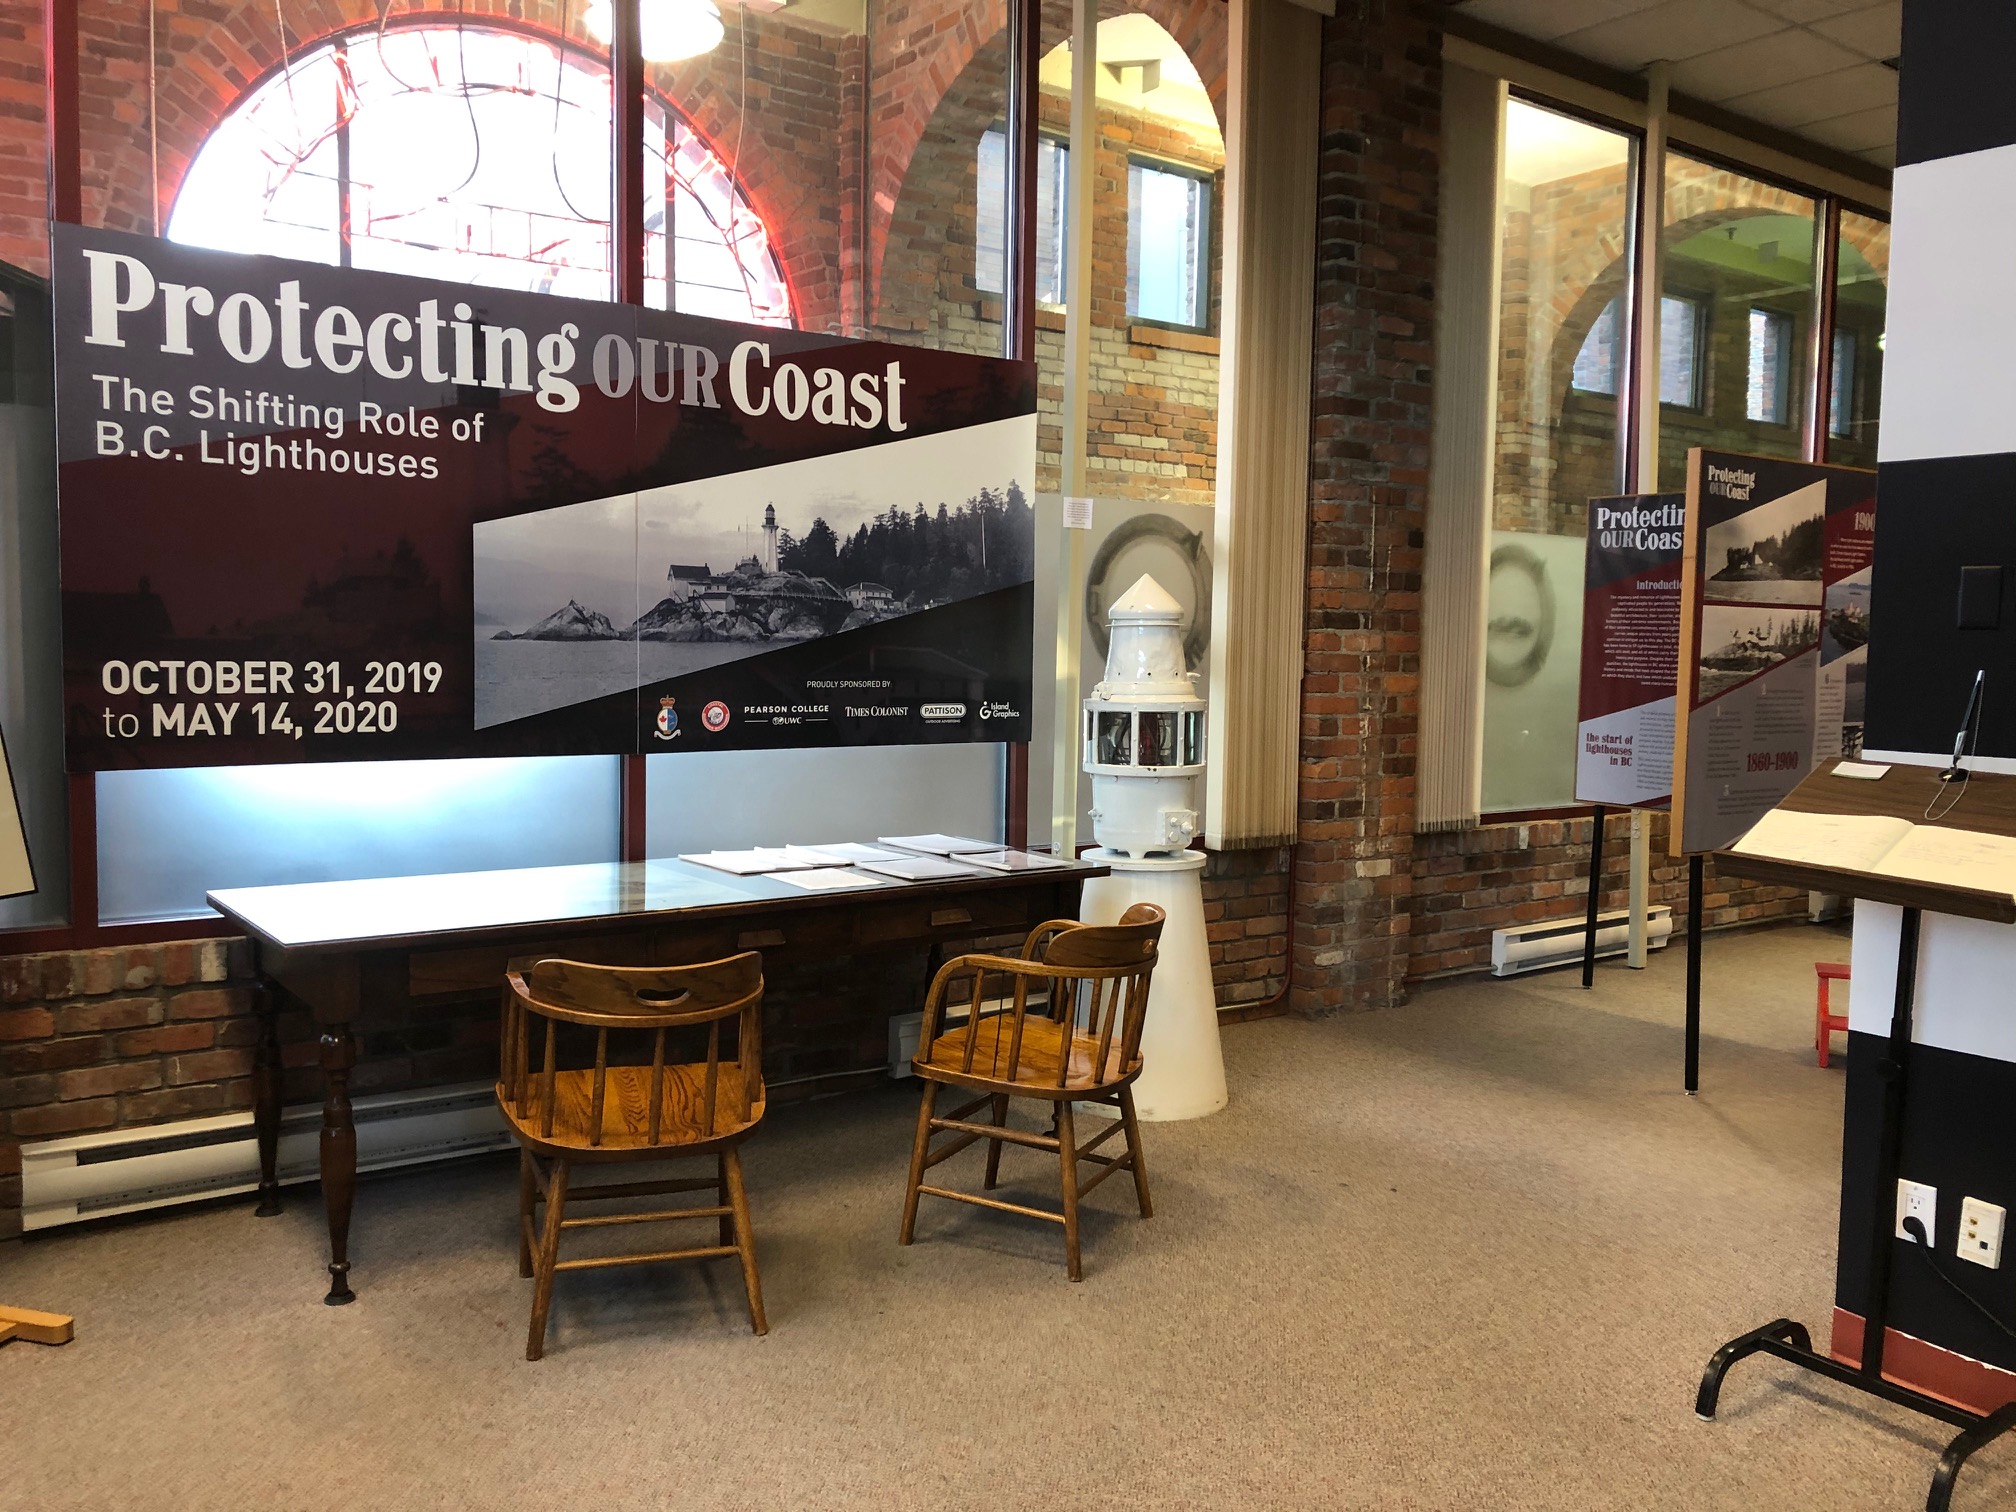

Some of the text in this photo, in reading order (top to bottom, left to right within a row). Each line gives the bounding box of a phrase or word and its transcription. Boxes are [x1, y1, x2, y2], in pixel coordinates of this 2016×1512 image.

[82, 249, 908, 432] Protecting OUR Coast
[92, 374, 485, 443] The Shifting Role of
[96, 420, 440, 480] B.C. Lighthouses
[1708, 465, 1755, 488] Protecting
[1709, 481, 1750, 501] OUR Coast
[1600, 528, 1685, 551] OUR Coas
[101, 660, 443, 699] OCTOBER 31, 2019
[806, 680, 839, 689] PROUDLY
[839, 680, 881, 688] SPONSORED
[744, 705, 830, 714] PEARSON COLLEGE
[844, 705, 909, 718] TIMES COLONIST
[924, 706, 963, 716] PATTISON
[990, 702, 1010, 711] Island
[102, 701, 397, 740] to MAY 14, 2020
[784, 717, 802, 725] UWC
[992, 709, 1020, 719] Graphics
[1586, 732, 1634, 745] the start of
[1585, 743, 1633, 757] lighthouses
[1609, 756, 1633, 767] in BC
[1746, 751, 1799, 772] 1860-1900
